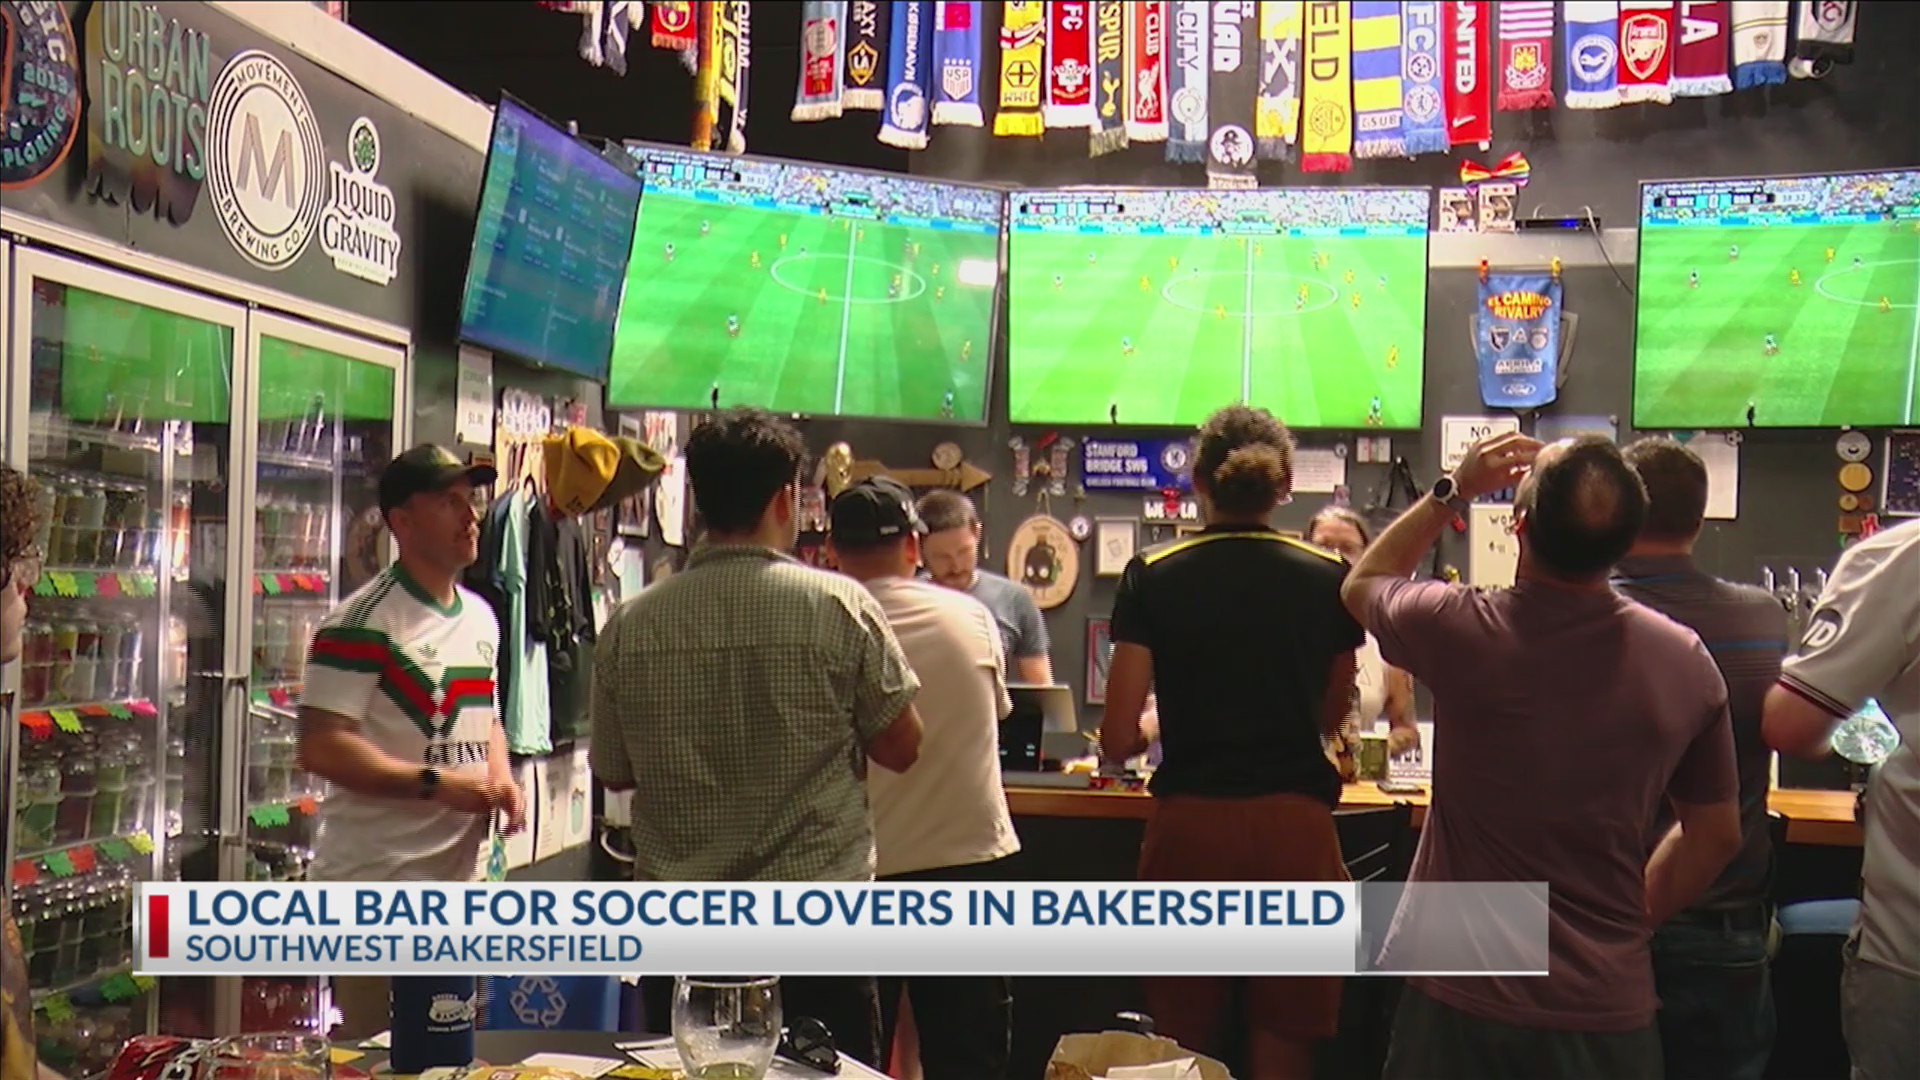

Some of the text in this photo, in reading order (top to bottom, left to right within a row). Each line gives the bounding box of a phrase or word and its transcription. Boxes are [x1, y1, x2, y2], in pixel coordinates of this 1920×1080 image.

[1061, 3, 1084, 31] FC
[1098, 1, 1121, 64] SPUR
[1145, 13, 1159, 56] CLUB
[1178, 11, 1199, 71] CITY
[1311, 2, 1340, 82] ELD
[1407, 4, 1434, 51] FC
[103, 1, 209, 103] URBAN
[24, 62, 69, 97] 2013
[236, 62, 304, 118] MOVEMENT
[0, 103, 67, 167] PLORING
[102, 59, 206, 180] ROOTS
[236, 111, 296, 211] M
[334, 170, 392, 224] LIQUID
[222, 198, 280, 260] BREWING
[323, 212, 398, 273] GRAVITY
[1487, 291, 1552, 307] EL CAMINO
[1494, 305, 1545, 320] RIVALRY
[1085, 442, 1138, 458] STAMFORD
[1470, 424, 1492, 439] NO
[1085, 458, 1148, 473] BRIDGE SW6
[1112, 477, 1140, 487] FOOTBALL
[1140, 476, 1157, 487] CLUB
[1144, 501, 1198, 519] WE LA
